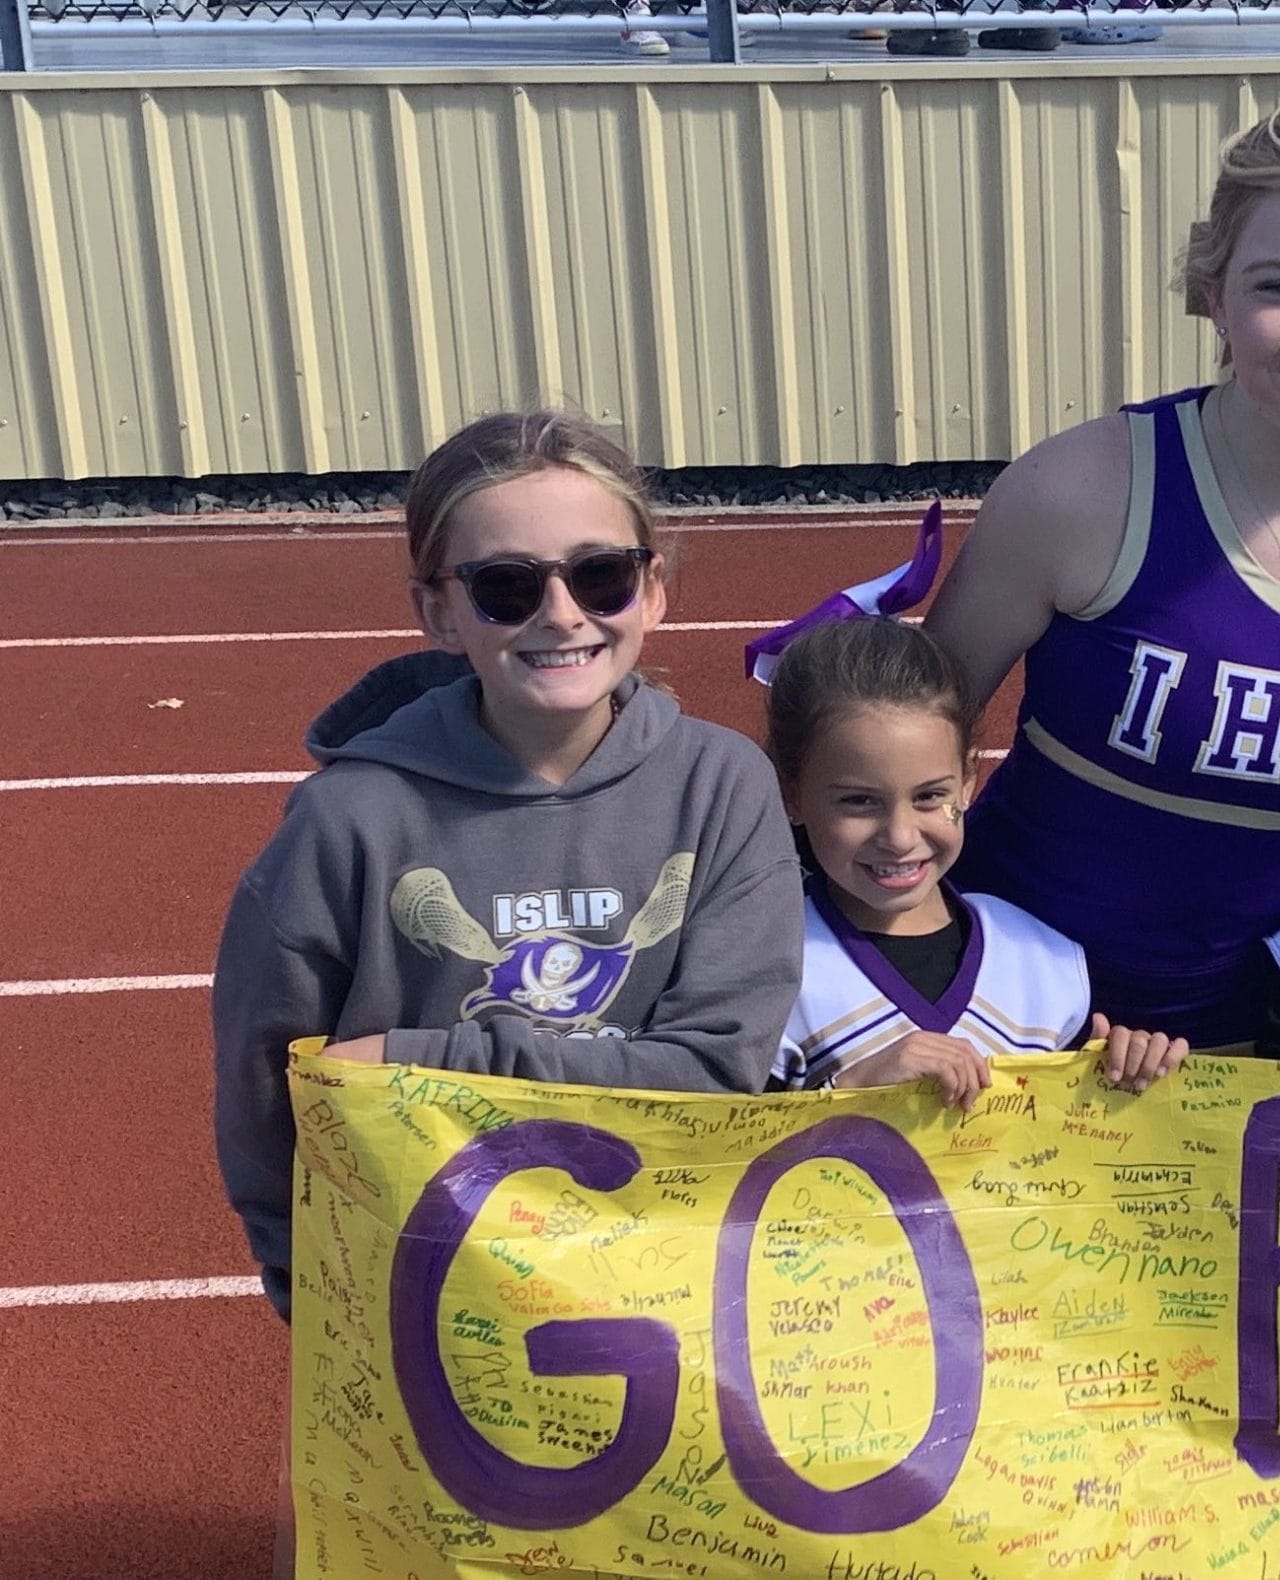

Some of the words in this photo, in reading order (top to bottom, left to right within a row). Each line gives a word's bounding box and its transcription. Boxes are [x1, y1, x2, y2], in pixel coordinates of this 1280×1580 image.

[494, 888, 623, 937] ISLIP
[386, 1069, 514, 1134] KATRINA
[390, 1114, 983, 1535] GO
[1057, 1350, 1159, 1382] Frankie
[646, 1514, 787, 1573] Benjamin
